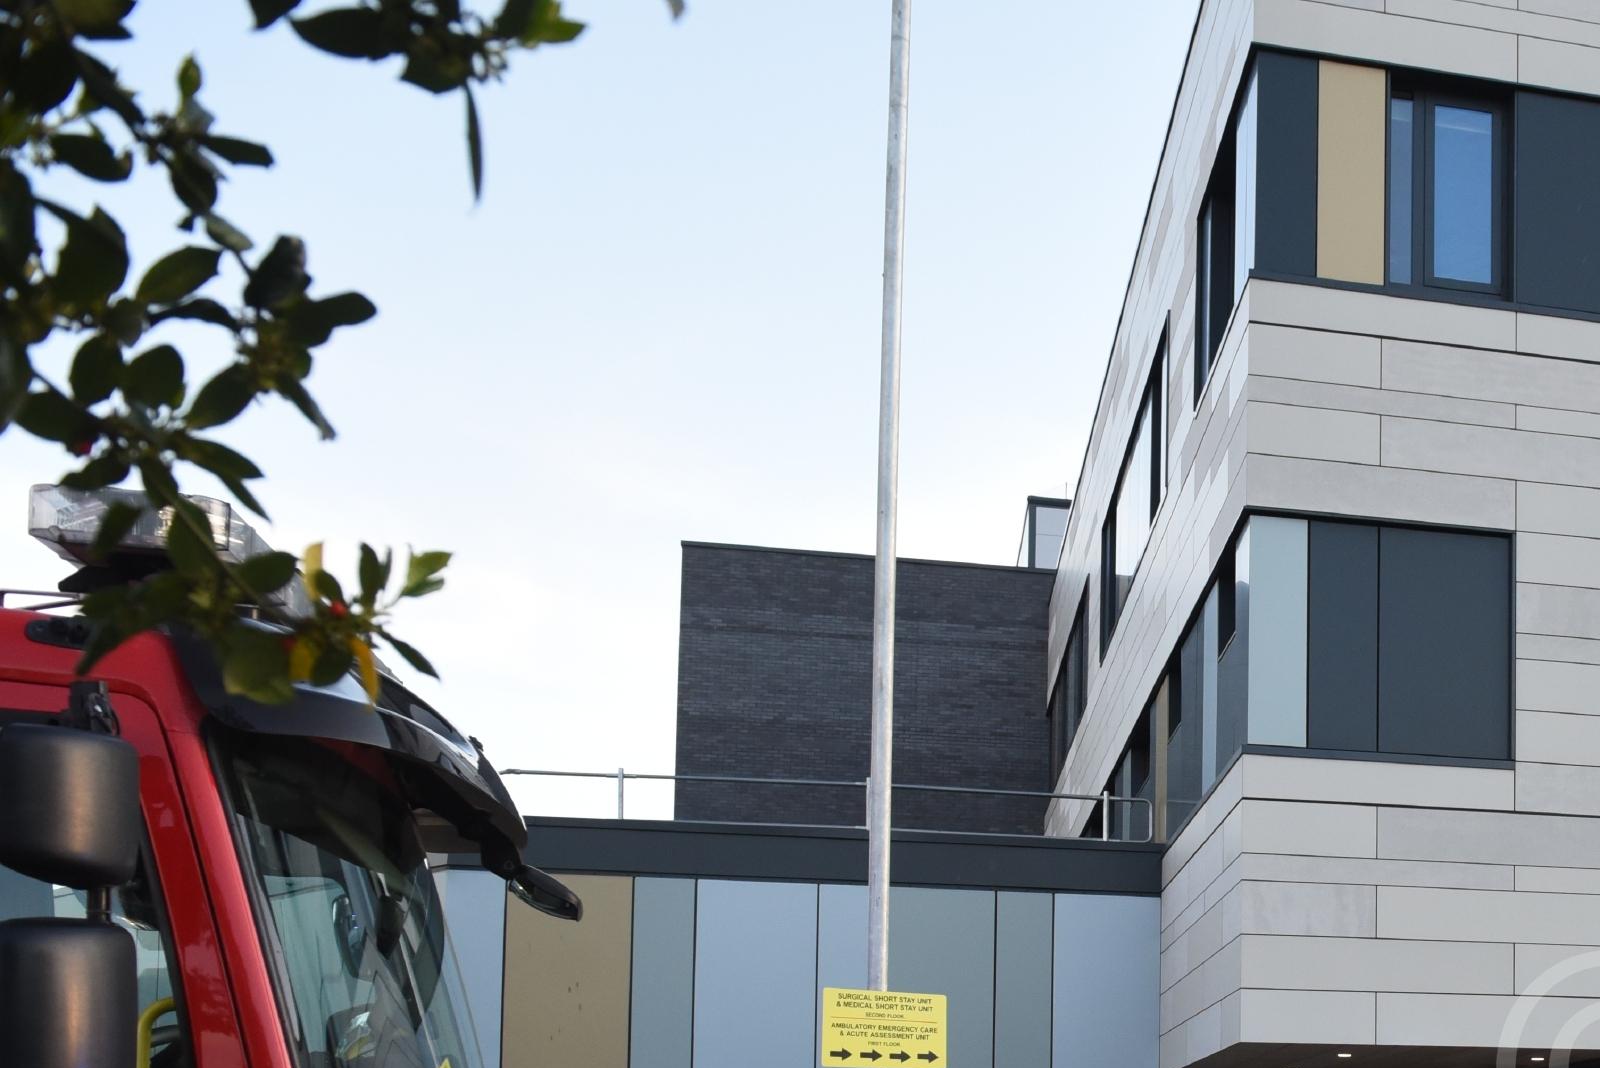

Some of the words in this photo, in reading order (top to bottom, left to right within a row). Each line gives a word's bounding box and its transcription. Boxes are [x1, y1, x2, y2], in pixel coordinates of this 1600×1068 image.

[837, 993, 871, 1001] SURGICAL
[874, 994, 897, 1002] SHORT
[899, 996, 915, 1004] STAY
[843, 1001, 872, 1009] MEDICAL
[900, 1004, 916, 1012] STAY
[831, 1022, 876, 1031] AMBULATORY
[878, 1025, 917, 1033] EMERGENCY
[870, 1032, 914, 1040] ASSESSMENT
